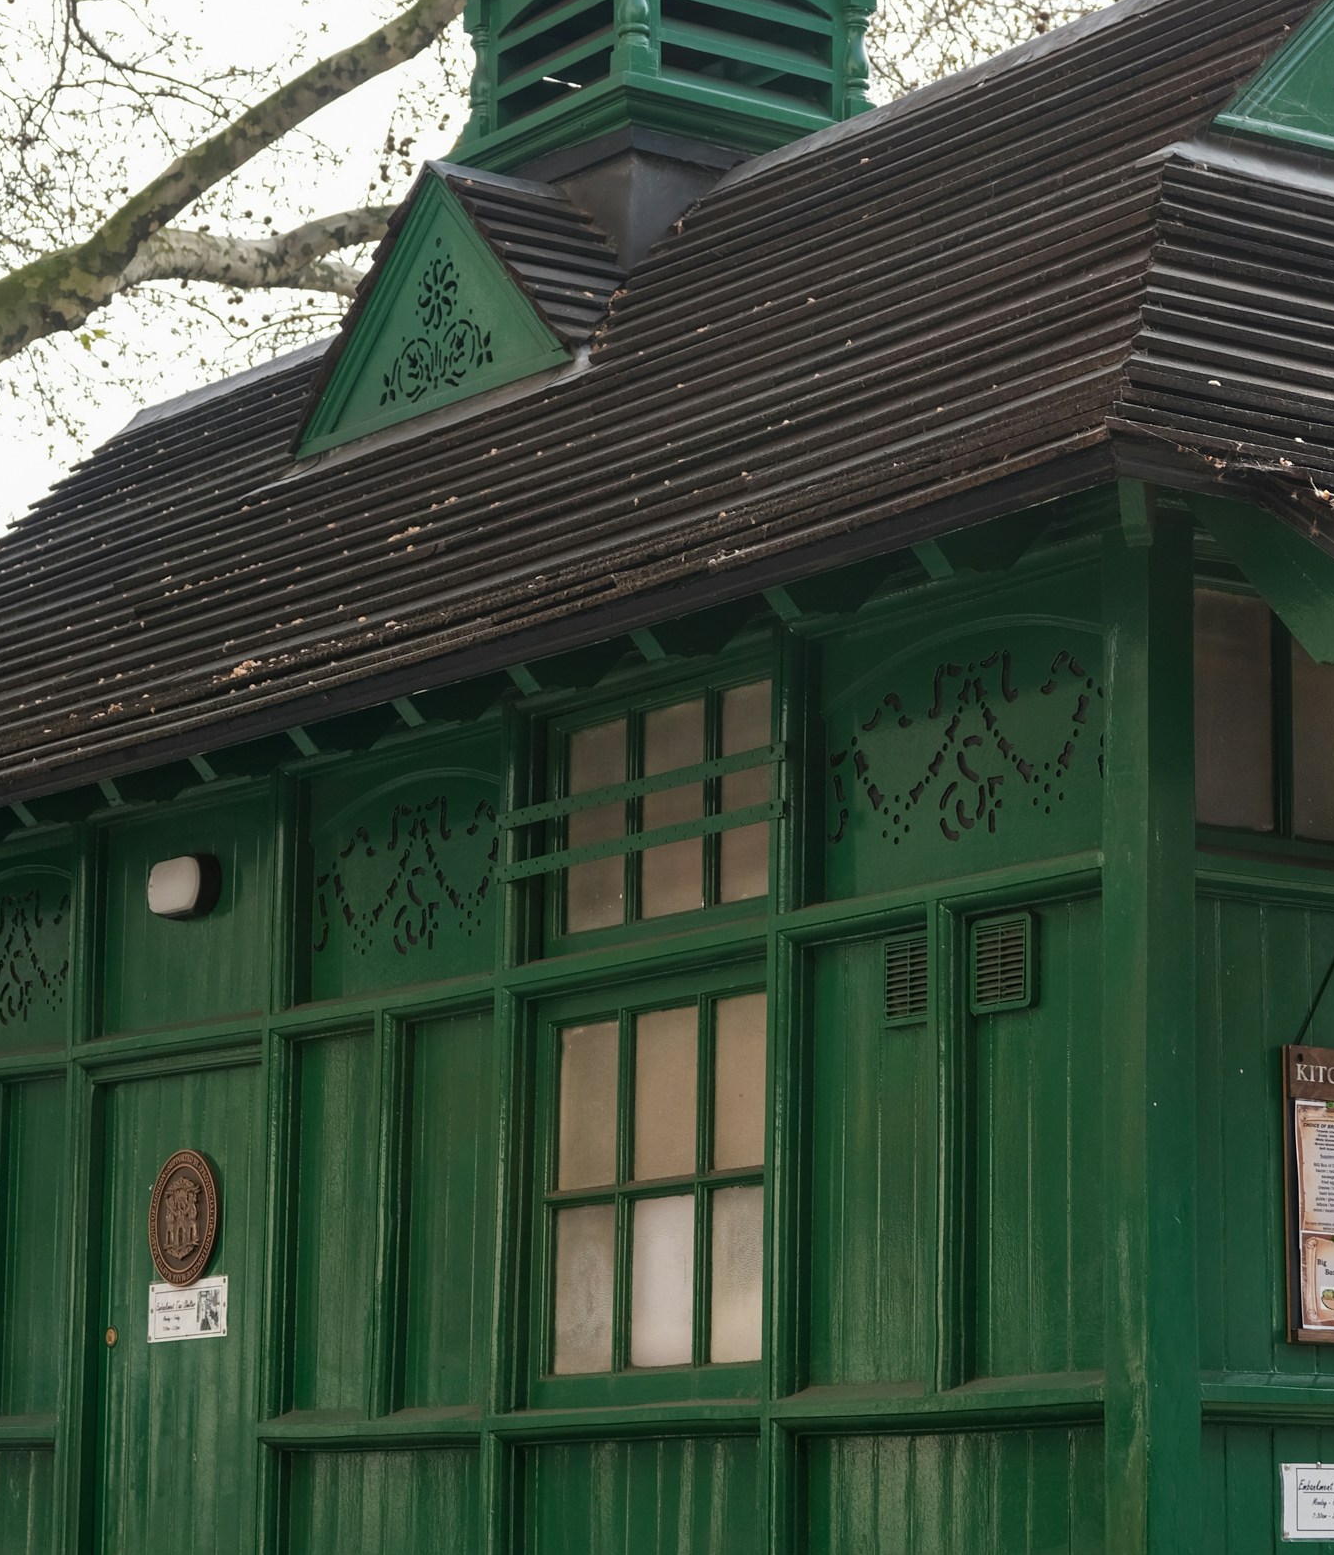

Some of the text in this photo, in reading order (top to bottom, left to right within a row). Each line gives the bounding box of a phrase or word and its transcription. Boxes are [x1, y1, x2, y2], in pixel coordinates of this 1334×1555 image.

[1317, 1259, 1327, 1267] Big
[1298, 1479, 1333, 1491] Embankment
[1312, 1497, 1327, 1508] Monday
